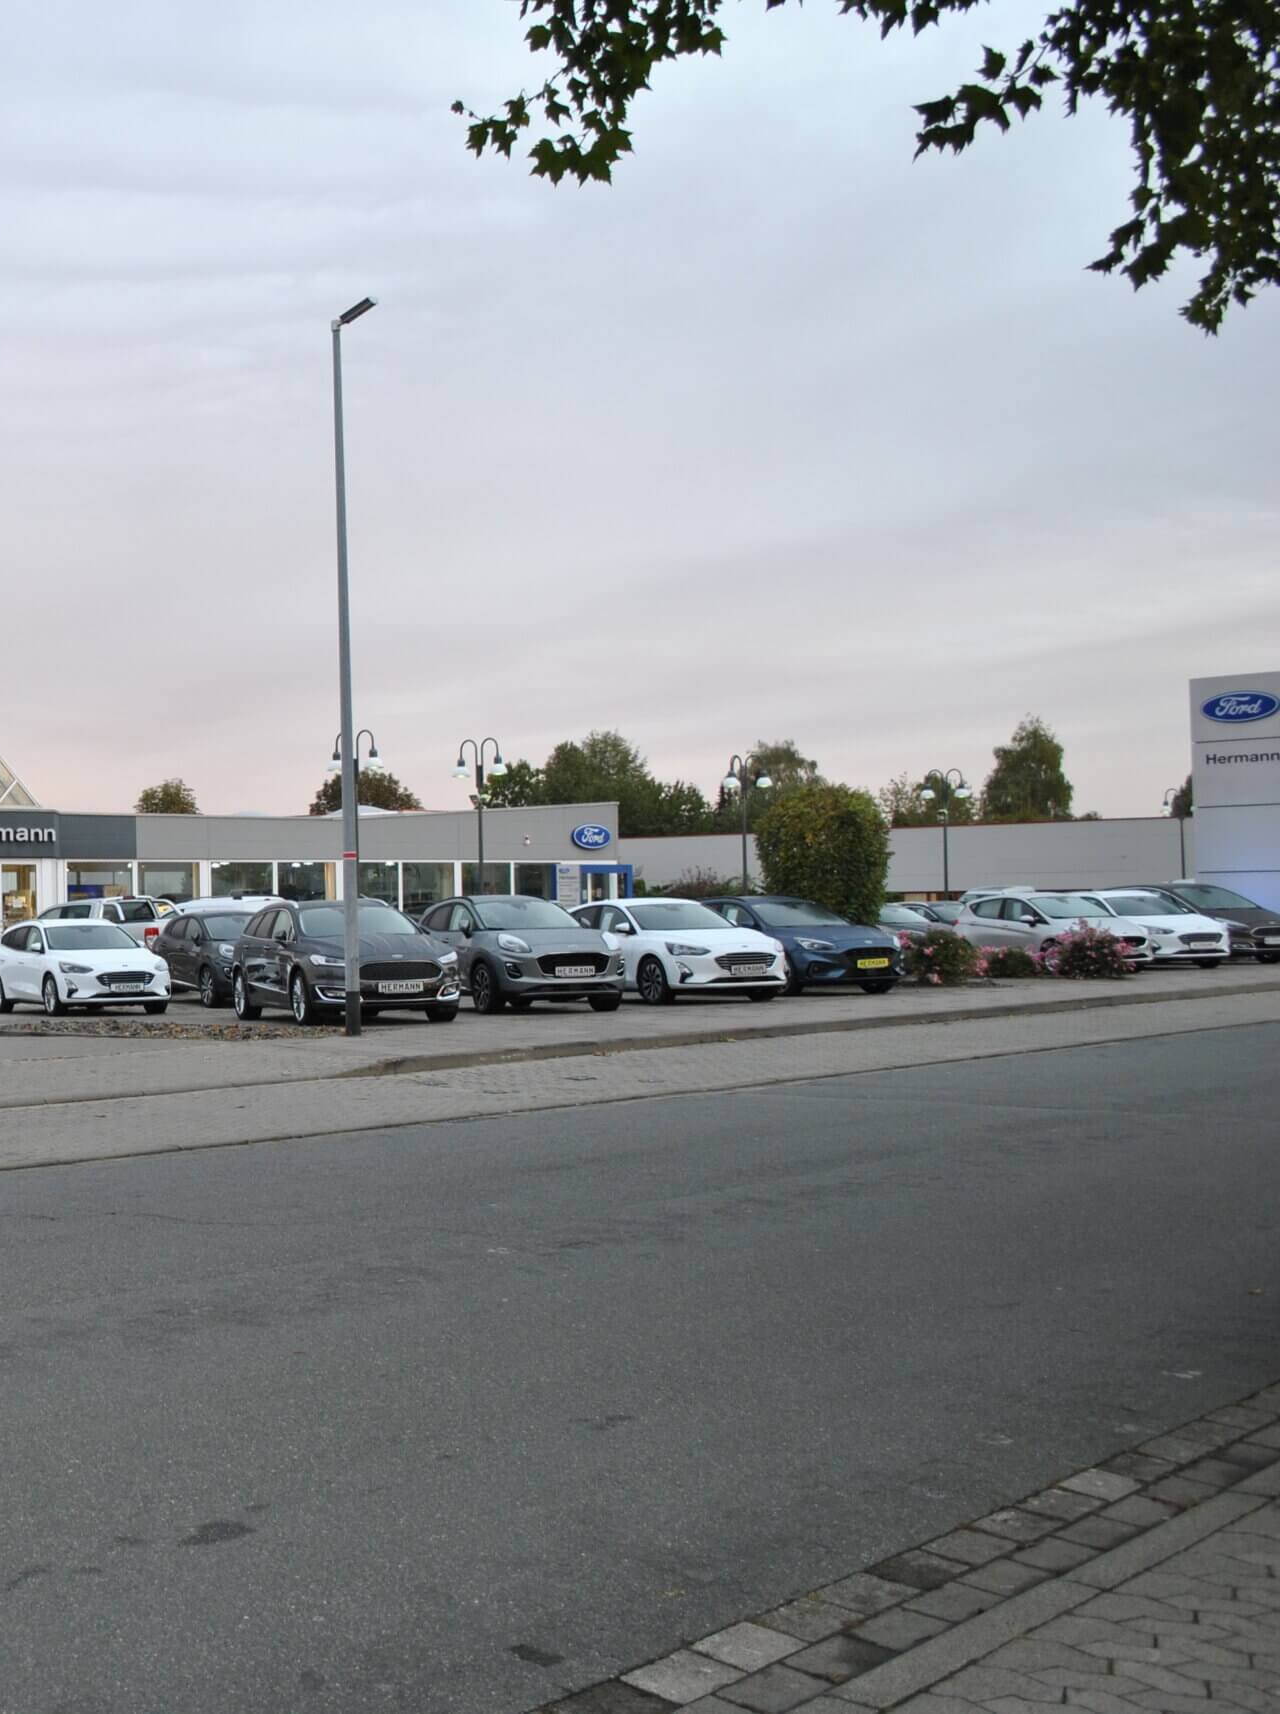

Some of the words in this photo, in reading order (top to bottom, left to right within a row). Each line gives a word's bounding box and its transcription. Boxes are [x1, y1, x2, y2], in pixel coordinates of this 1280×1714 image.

[1214, 695, 1263, 717] Ford
[1205, 752, 1280, 765] Hermann
[557, 967, 594, 976] HERMANN
[381, 982, 421, 992] HERMANN
